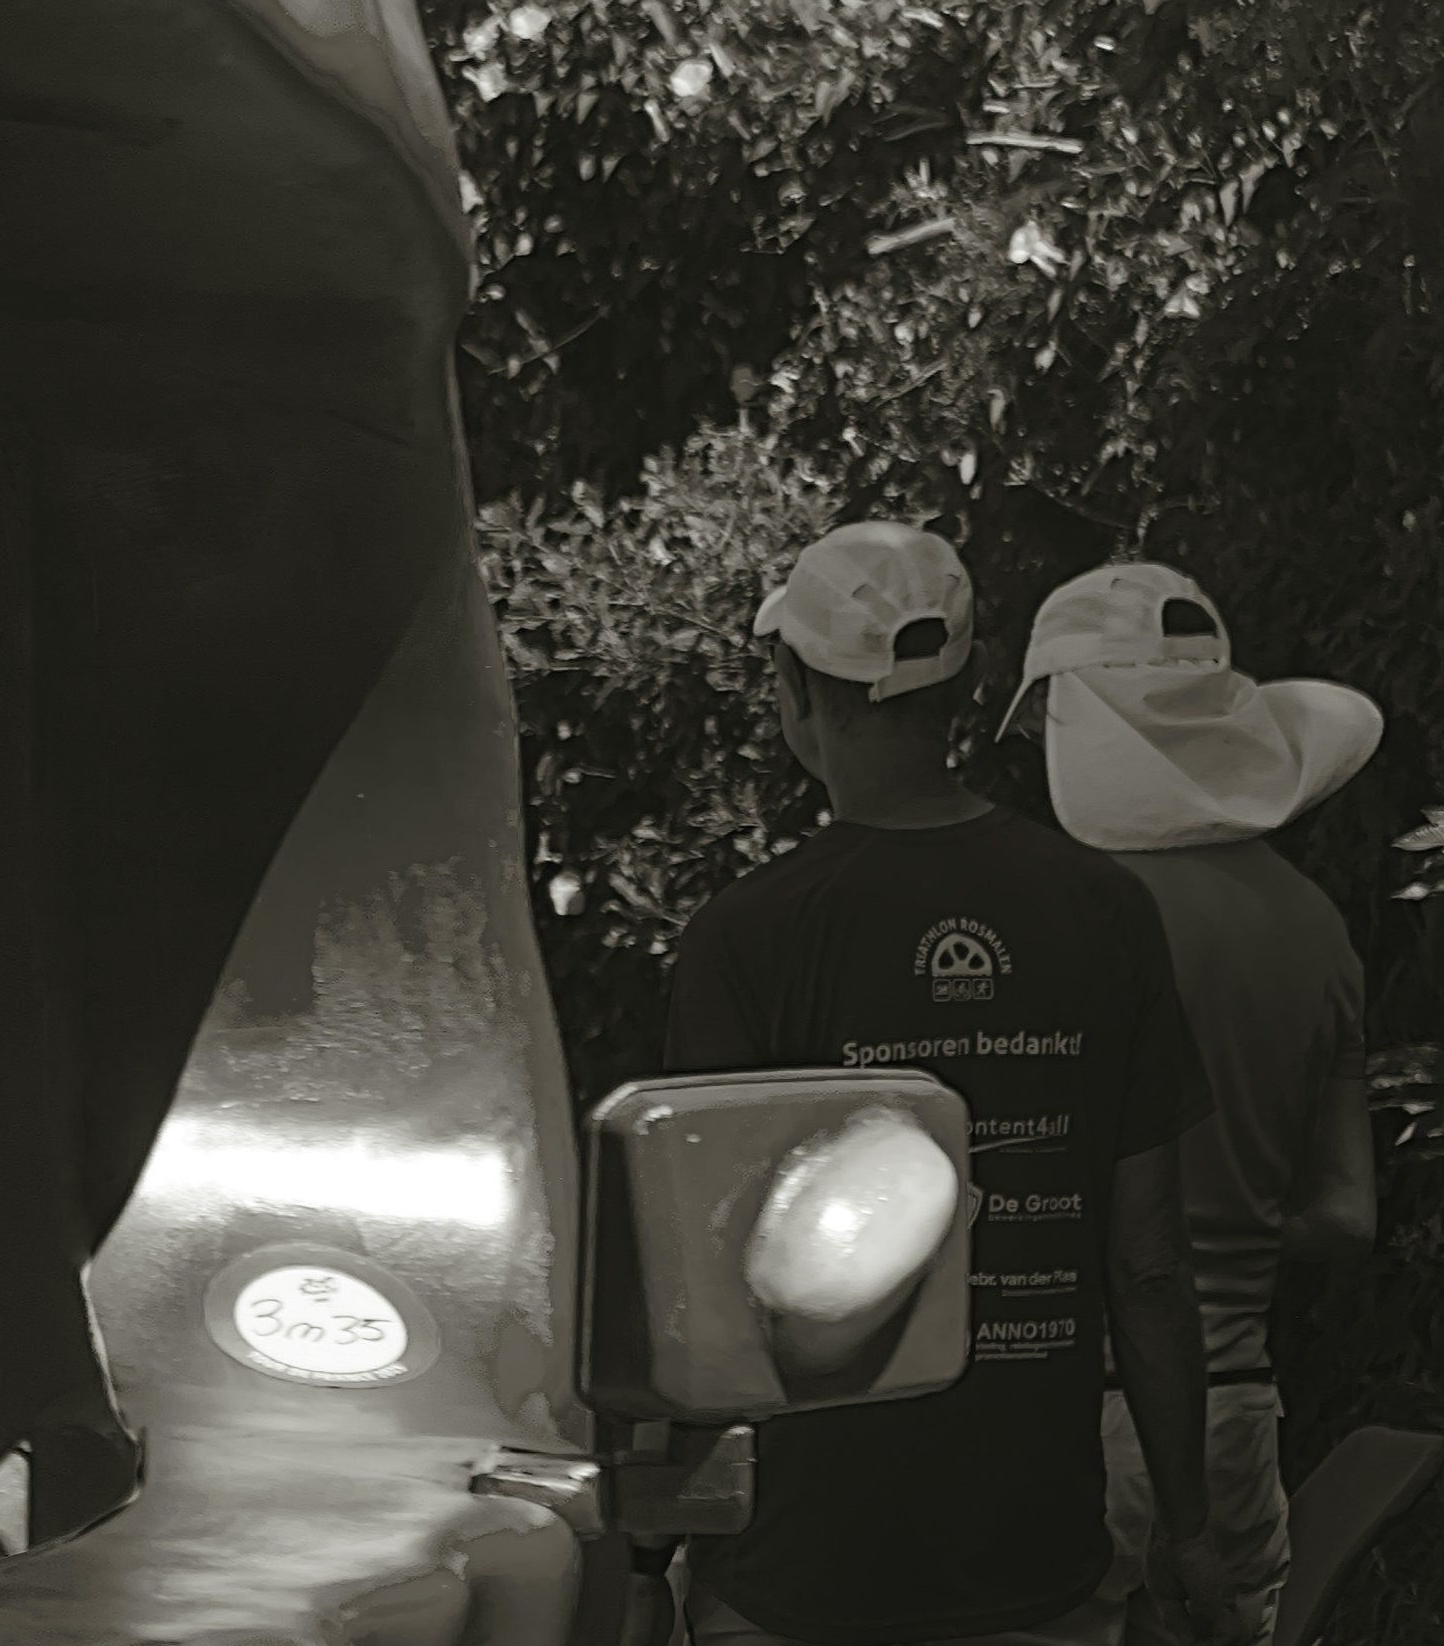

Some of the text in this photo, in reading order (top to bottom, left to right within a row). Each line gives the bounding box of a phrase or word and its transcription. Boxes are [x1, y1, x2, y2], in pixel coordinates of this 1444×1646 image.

[914, 916, 1013, 976] TRIATHLON ROSMALEN
[841, 1028, 1084, 1069] Sponsoren bedankt!
[966, 1114, 1069, 1136] ontent4all
[988, 1193, 1082, 1213] De Groot
[1000, 1274, 1027, 1286] van
[1027, 1270, 1052, 1286] der
[975, 1317, 1076, 1341] ANNO1970
